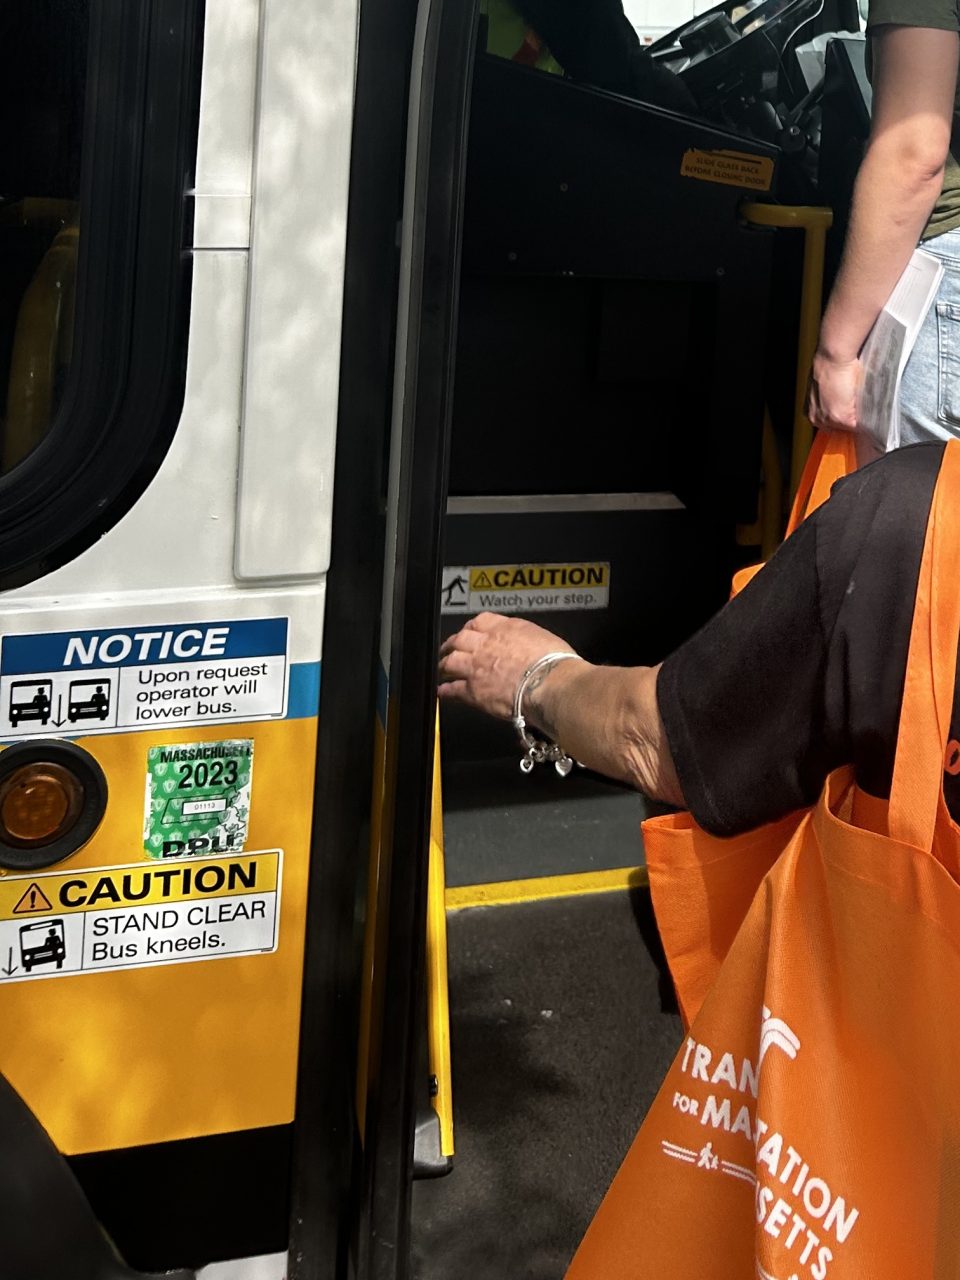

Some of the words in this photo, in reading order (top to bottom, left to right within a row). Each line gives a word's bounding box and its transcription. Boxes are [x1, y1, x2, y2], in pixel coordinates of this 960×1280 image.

[494, 567, 604, 588] CAUTION
[480, 592, 524, 607] Watch
[527, 594, 560, 605] your
[564, 592, 597, 605] step.
[63, 626, 230, 666] NOTICE
[138, 667, 190, 687] Upon
[196, 662, 269, 682] request
[136, 687, 219, 706] operator
[224, 680, 258, 697] will
[135, 703, 191, 721] lower
[196, 699, 237, 716] bus.
[178, 760, 238, 789] 2023
[162, 834, 236, 858] DPU
[58, 861, 257, 908] CAUTION
[92, 911, 179, 937] STAND
[187, 900, 266, 926] CLEAR
[92, 943, 138, 962] Bus
[146, 930, 227, 955] kneels.
[673, 1091, 698, 1116] FOR
